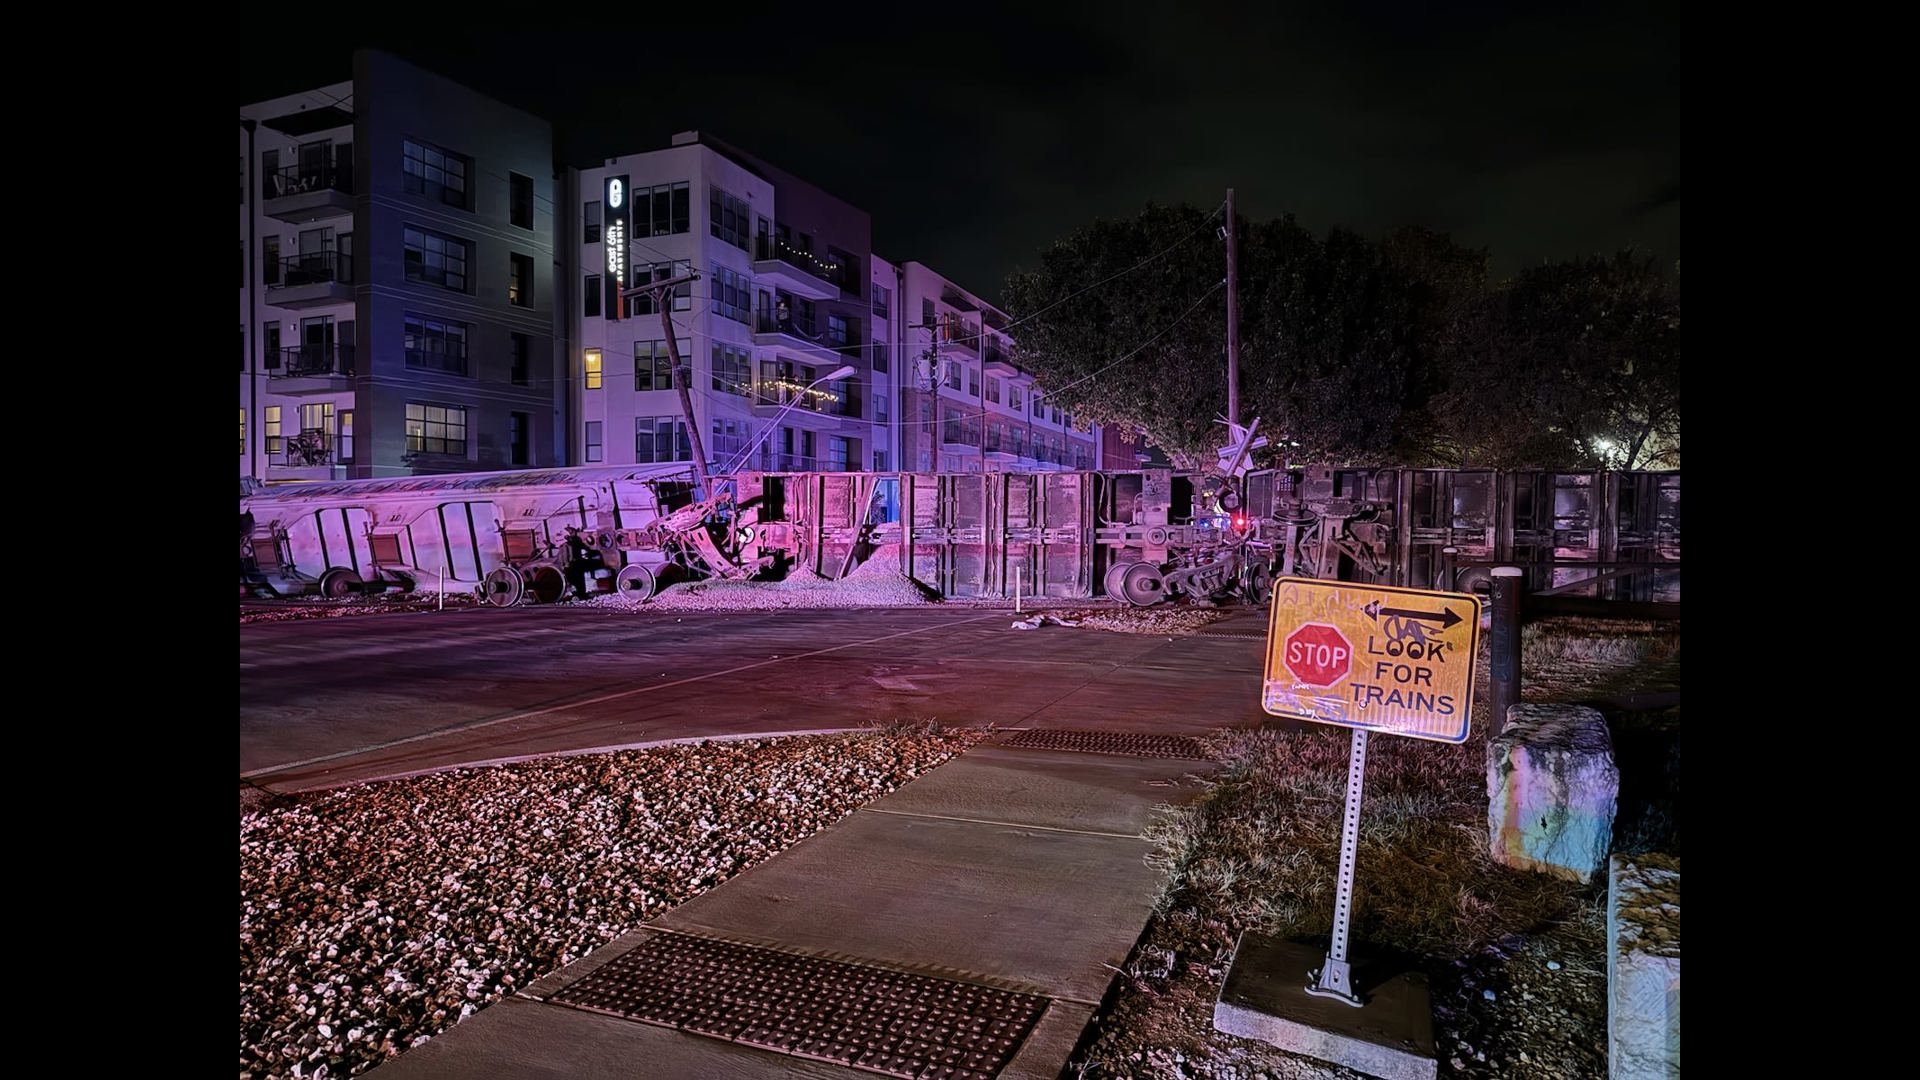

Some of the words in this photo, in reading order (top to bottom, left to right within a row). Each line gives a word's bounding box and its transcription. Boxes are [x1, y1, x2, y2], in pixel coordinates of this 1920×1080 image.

[607, 225, 616, 246] 6th
[608, 247, 616, 273] east
[1288, 641, 1347, 669] STOP
[1368, 635, 1445, 663] LOOK
[1375, 661, 1433, 687] FOR
[1349, 682, 1455, 715] TRAINS
